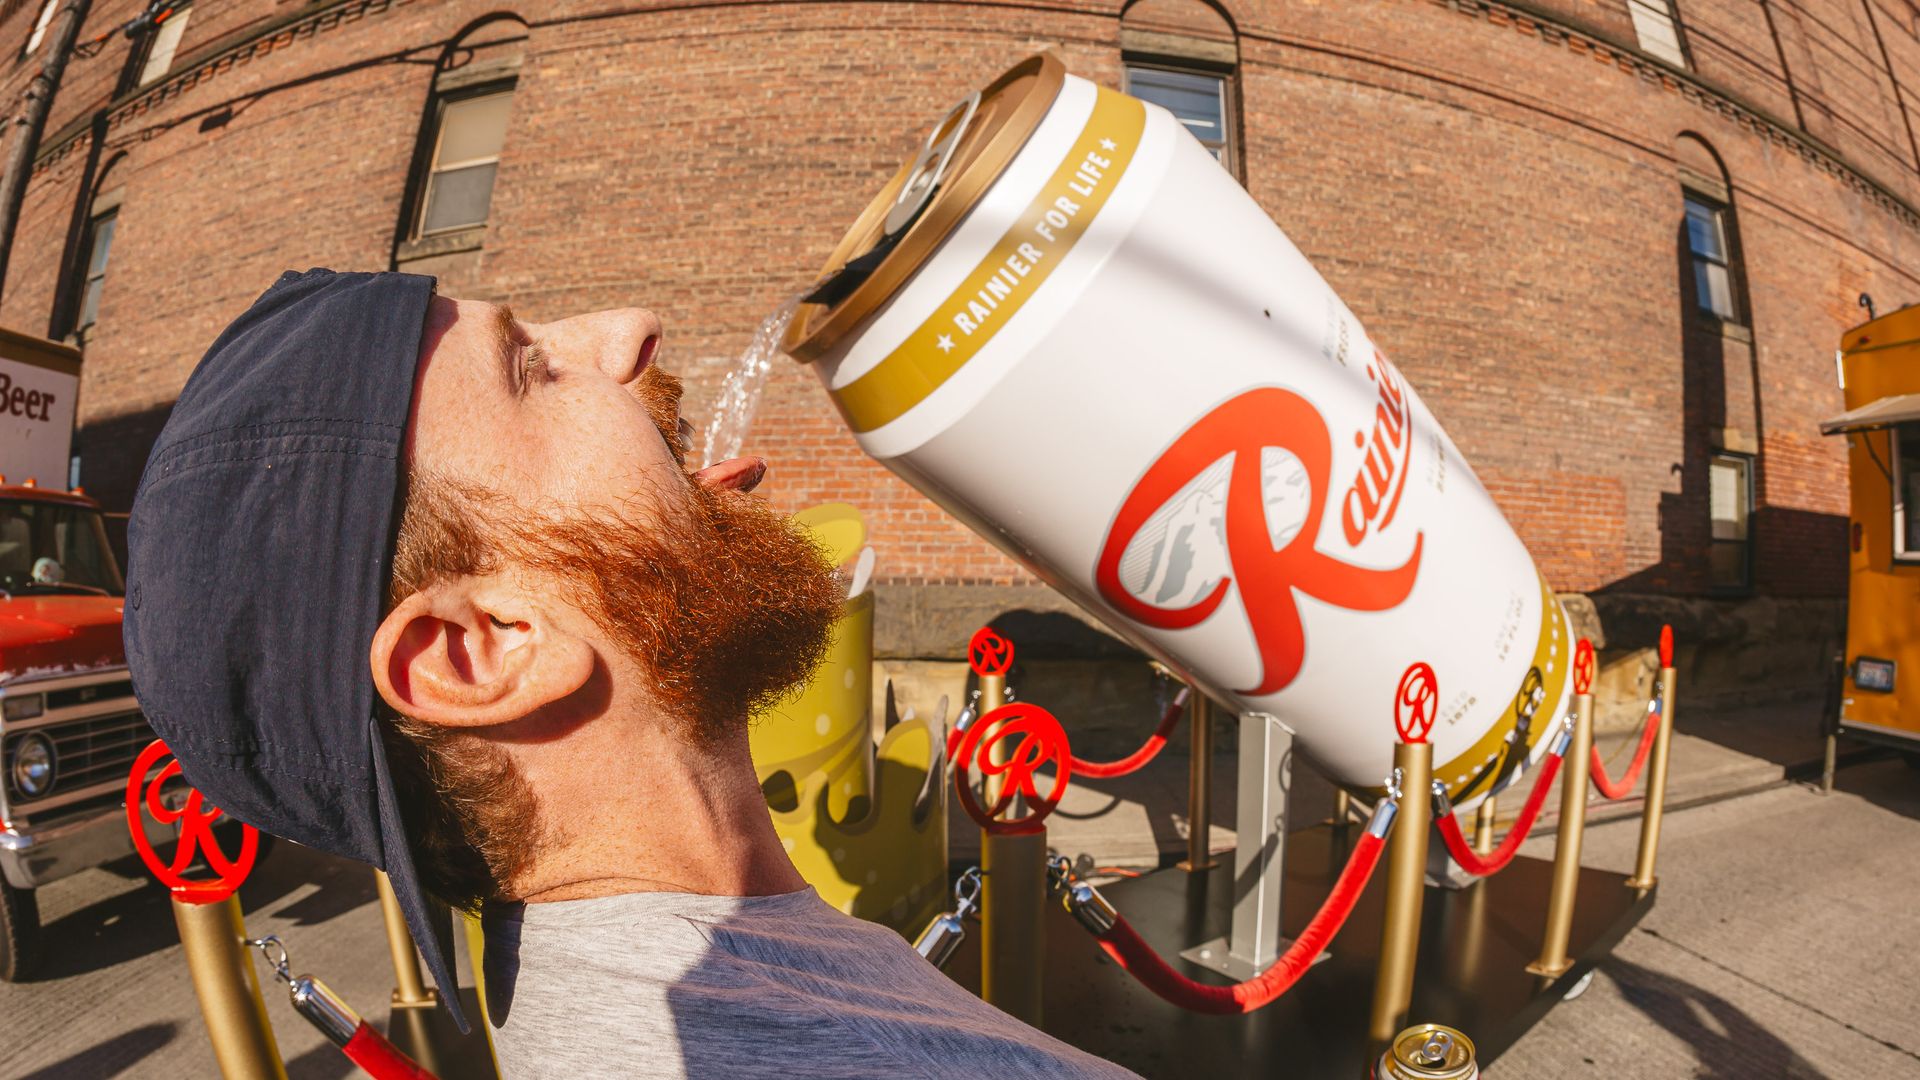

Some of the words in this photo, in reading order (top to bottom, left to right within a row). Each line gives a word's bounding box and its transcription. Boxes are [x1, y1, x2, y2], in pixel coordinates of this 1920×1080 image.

[953, 241, 1044, 336] RAINIER
[1035, 196, 1081, 243] FOR
[1068, 151, 1112, 198] LIFE
[1095, 347, 1424, 697] Rainie
